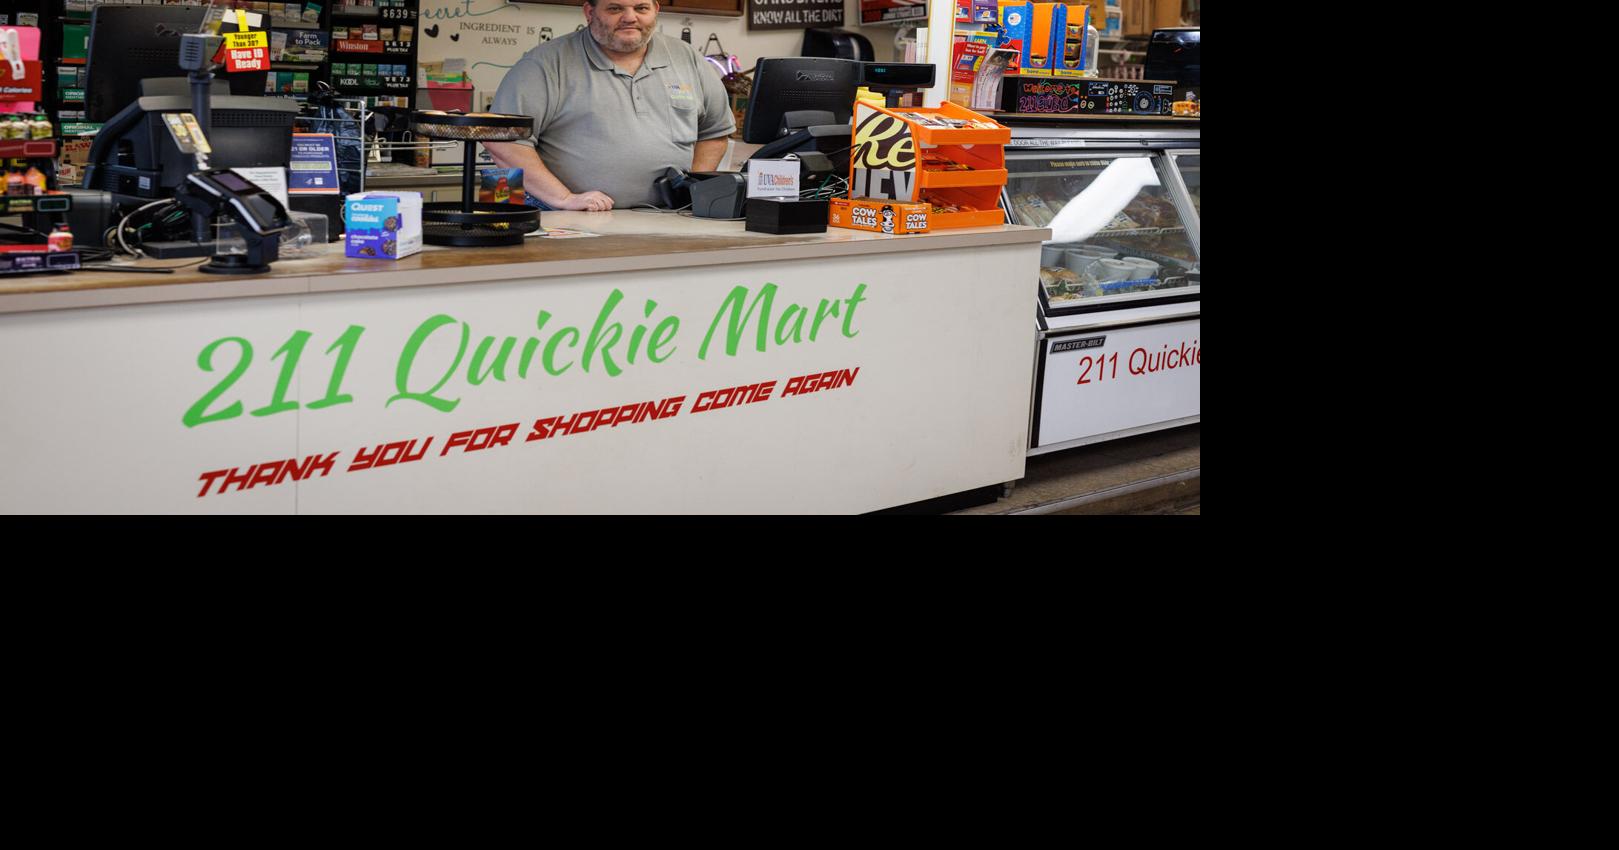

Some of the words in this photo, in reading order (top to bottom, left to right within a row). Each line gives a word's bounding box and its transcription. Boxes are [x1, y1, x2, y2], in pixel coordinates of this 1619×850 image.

[753, 11, 784, 24] KNOW
[785, 10, 802, 23] ALL
[803, 10, 821, 23] THE
[822, 9, 843, 22] DIRT
[460, 22, 521, 34] INGREDIENT
[527, 26, 535, 34] IS
[233, 33, 257, 41] Younger
[481, 37, 518, 46] ALWAYS
[339, 41, 369, 51] Winston
[231, 50, 252, 60] Have
[253, 48, 264, 59] ID
[235, 59, 262, 69] Ready
[340, 78, 359, 86] KOOL
[852, 207, 877, 217] COW
[907, 213, 928, 222] COW
[851, 215, 877, 227] TALES
[906, 222, 928, 230] TALES
[1054, 338, 1105, 351] MASTER-BILT
[182, 325, 364, 428] 211
[386, 289, 680, 414] Quickie
[698, 283, 866, 360] Mart
[1077, 352, 1118, 385] 211
[198, 451, 338, 497] THANK
[347, 436, 434, 472] YOU
[440, 422, 520, 457] FOR
[525, 395, 686, 442] SHOPPING
[690, 380, 777, 414] COME
[781, 367, 860, 398] AGAIN
